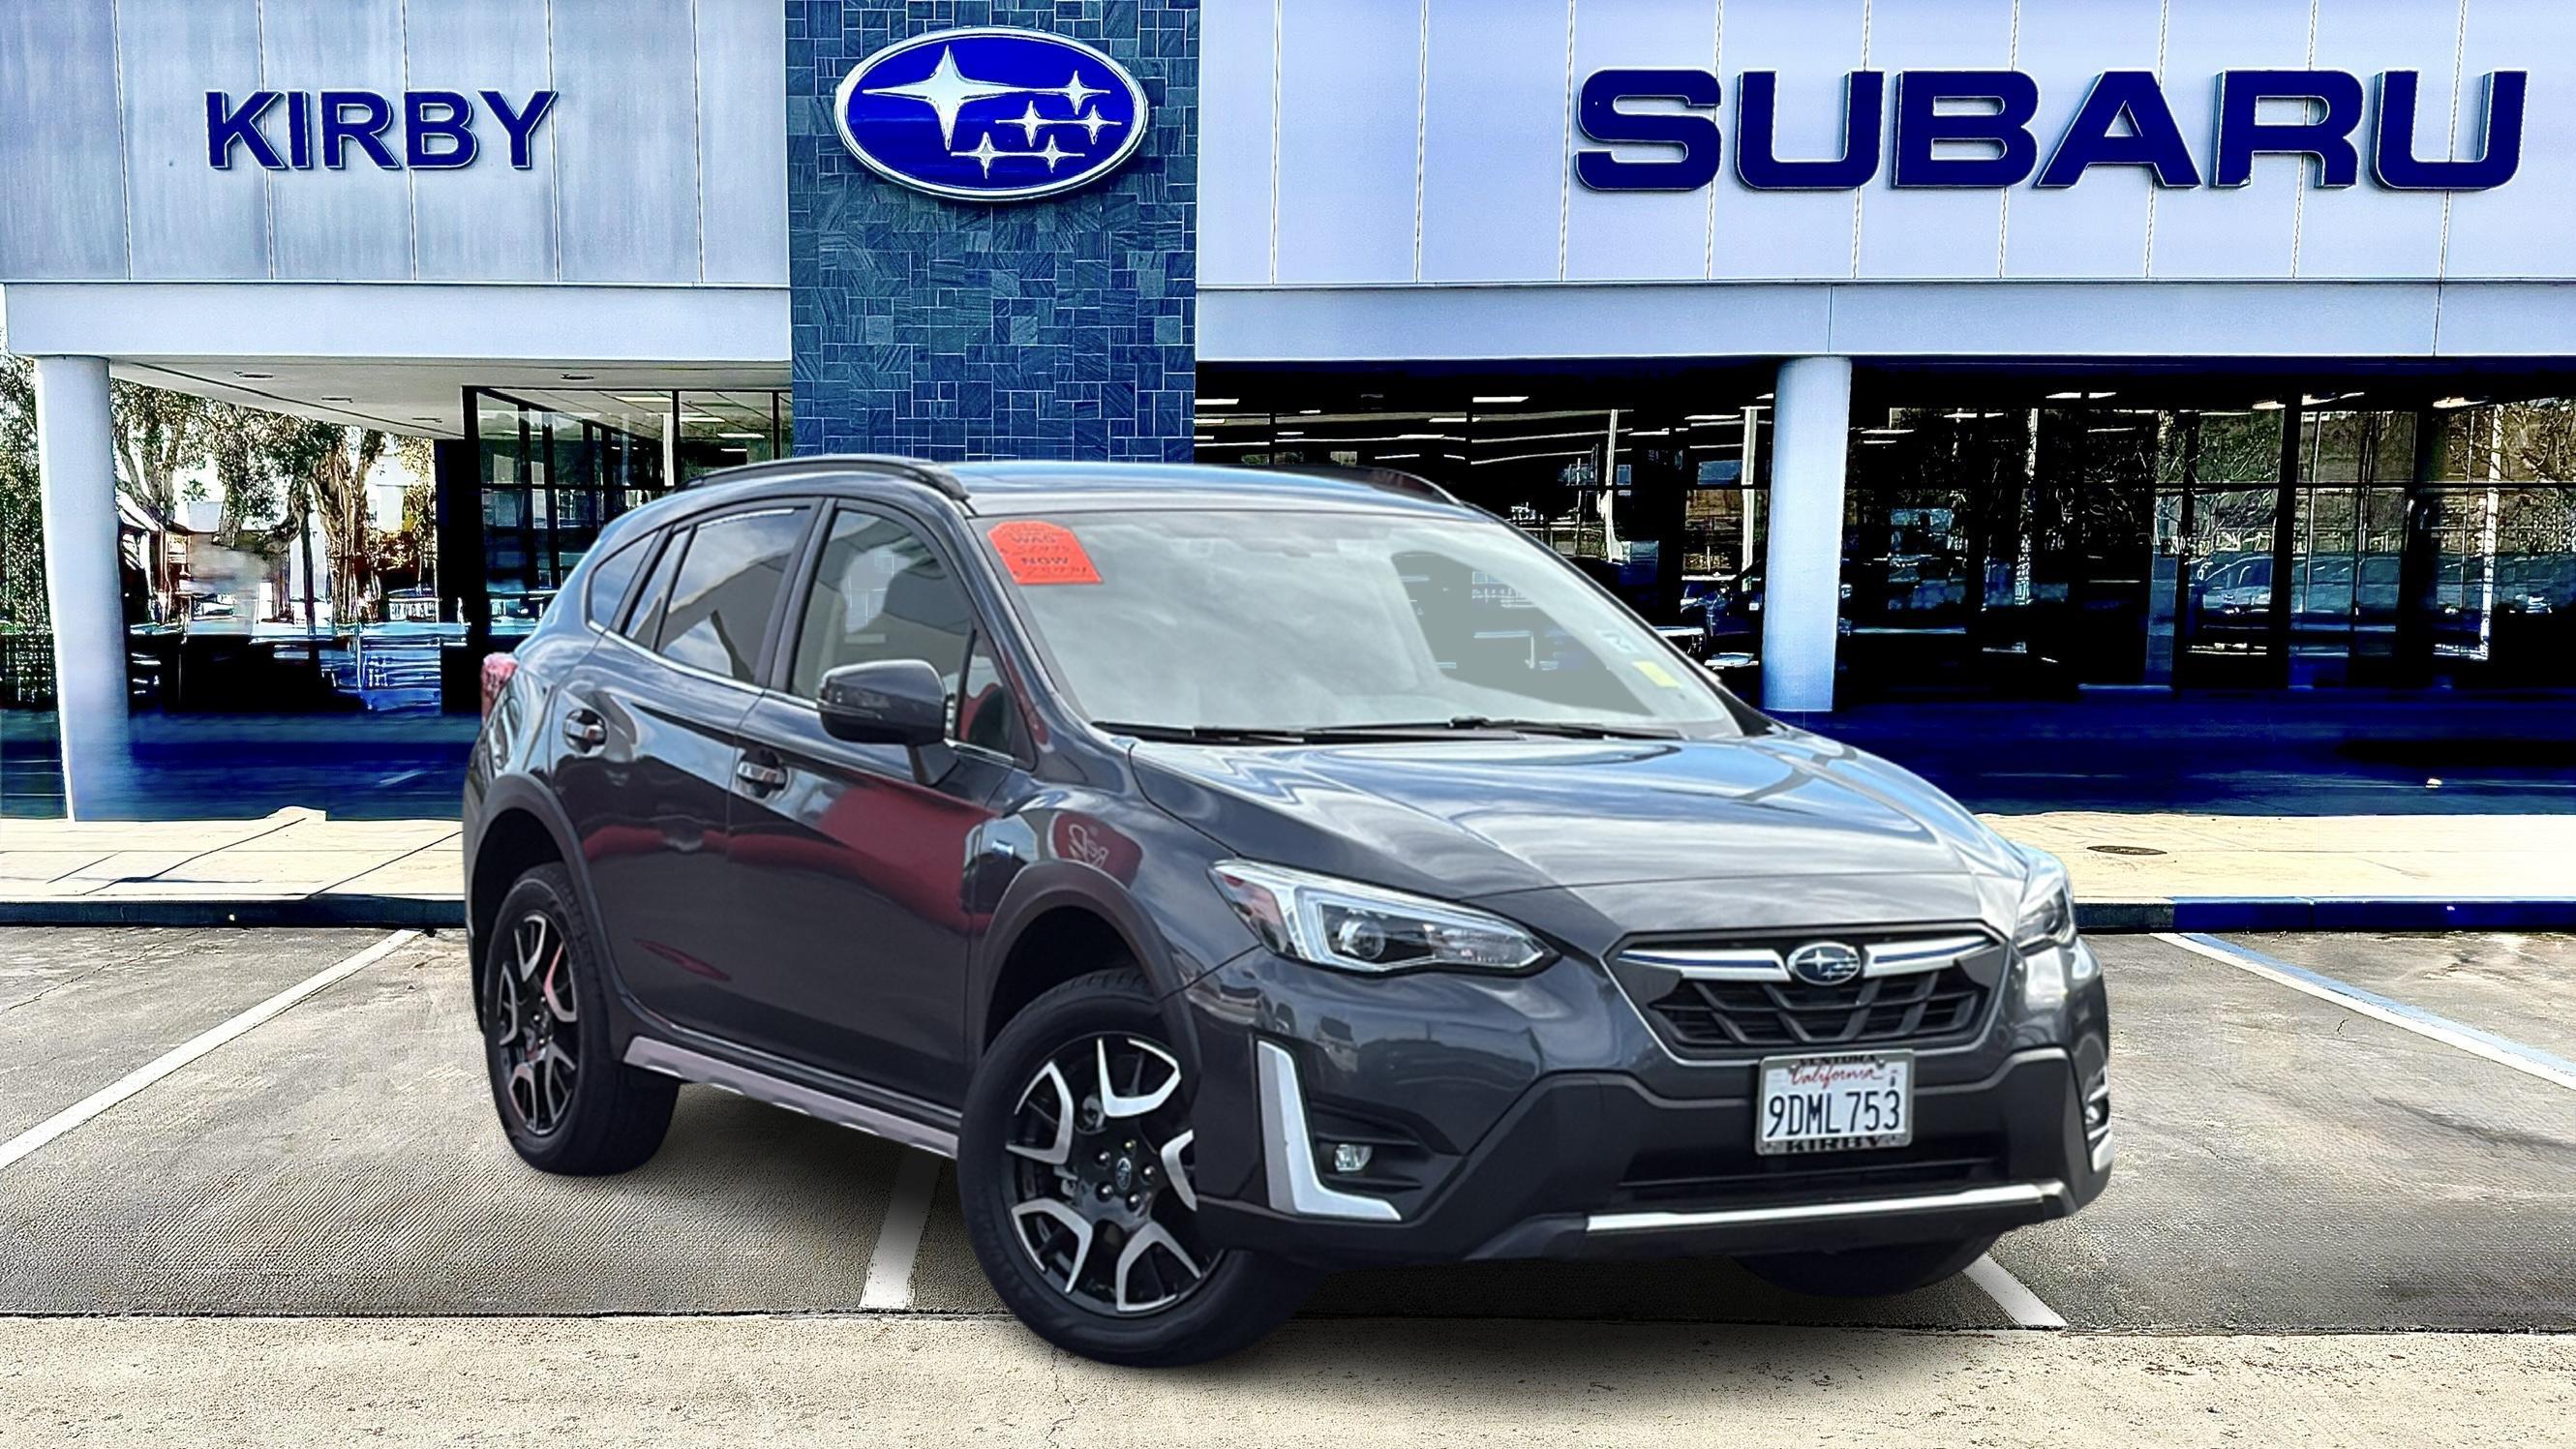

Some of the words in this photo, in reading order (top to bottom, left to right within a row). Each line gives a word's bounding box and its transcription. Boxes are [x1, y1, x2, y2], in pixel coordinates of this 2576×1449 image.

[204, 90, 559, 169] KIRBY
[1574, 69, 2529, 191] SUBARU
[1799, 1054, 1877, 1066] VENTURA
[1791, 1066, 1884, 1089] California
[1786, 1134, 1884, 1151] KIRBY
